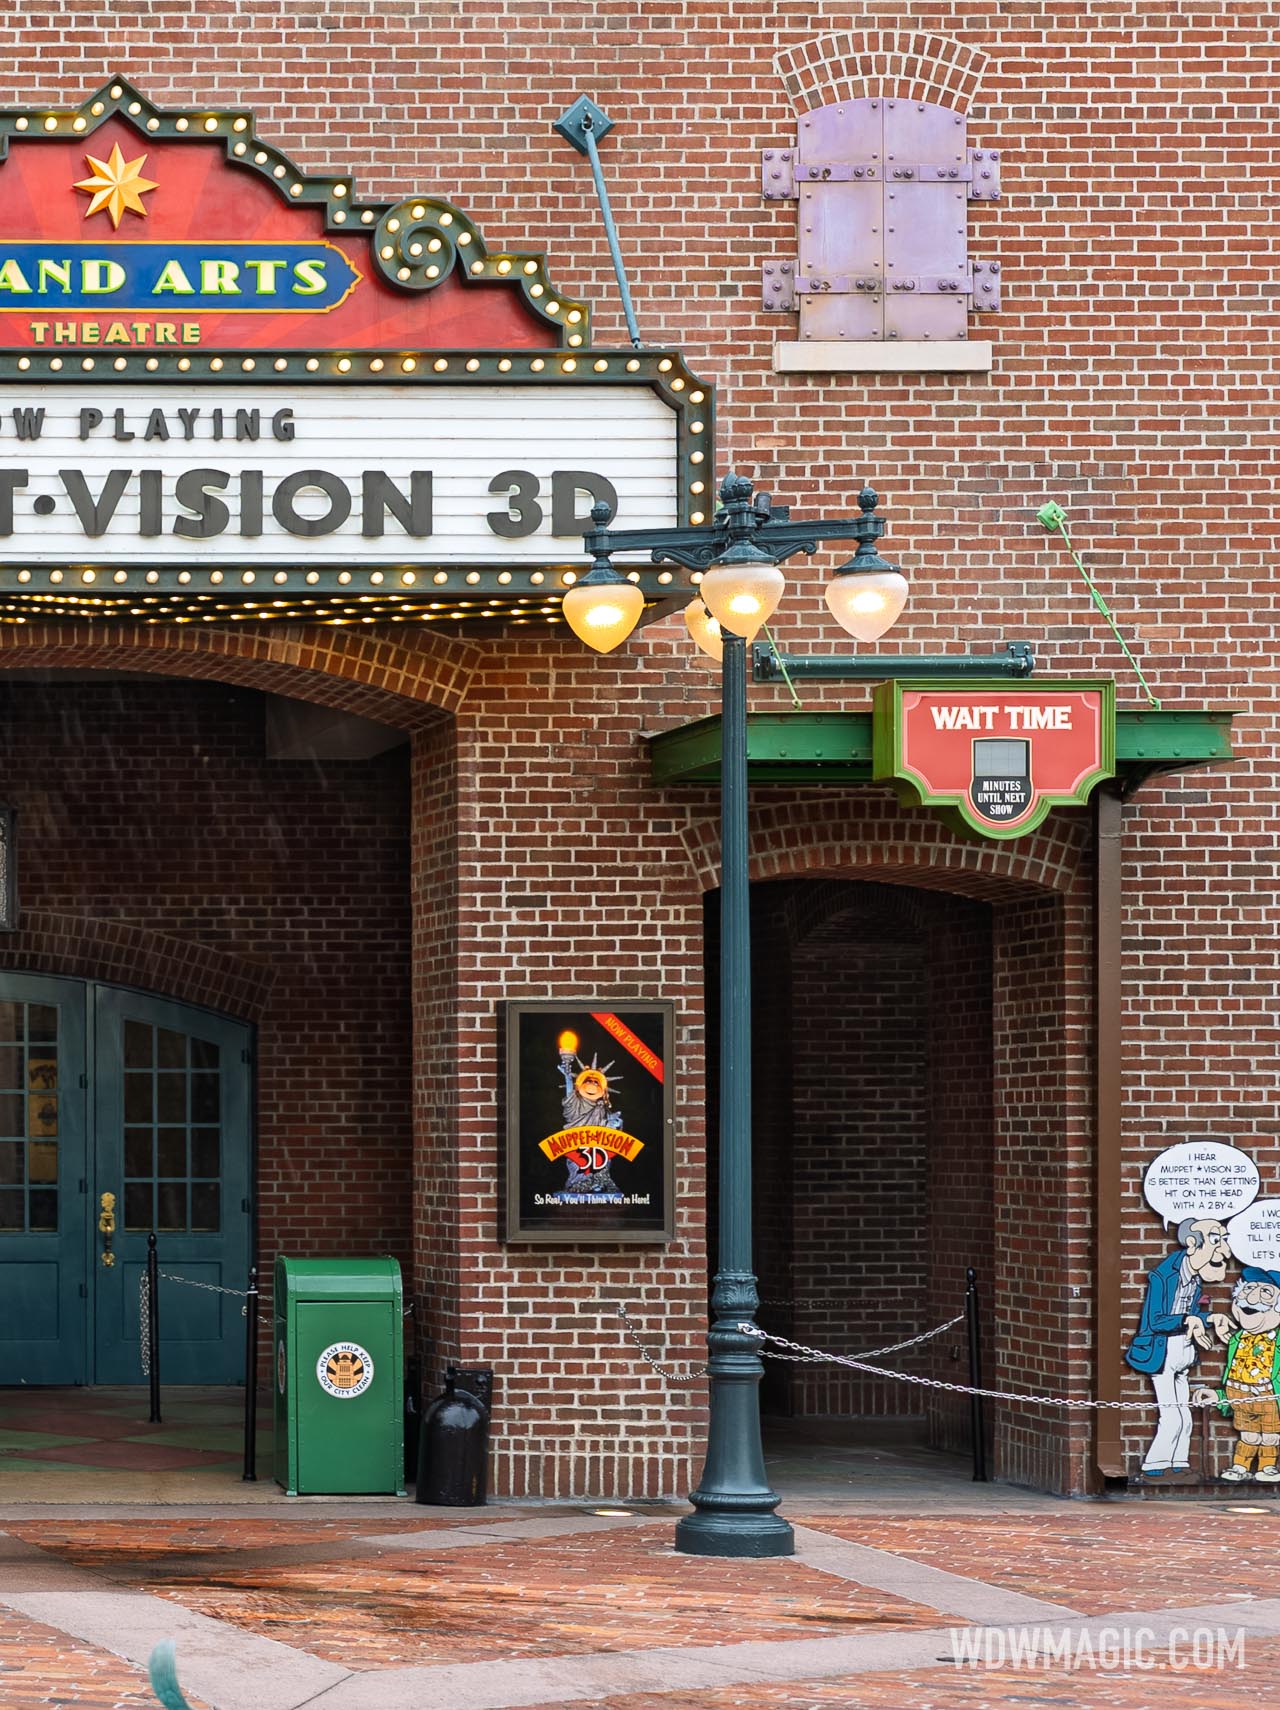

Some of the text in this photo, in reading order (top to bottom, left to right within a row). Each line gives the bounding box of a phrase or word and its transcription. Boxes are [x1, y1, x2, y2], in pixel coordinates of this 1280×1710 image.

[151, 259, 328, 295] ARTS
[30, 321, 201, 344] THEATRE
[79, 408, 295, 441] PLAYING
[487, 469, 618, 538] 3D
[930, 705, 1073, 730] WAIT TIME
[982, 780, 1021, 792] MINUTES
[977, 792, 1026, 803] UNTIL NEXT
[989, 804, 1014, 815] SHOW
[605, 1017, 658, 1070] NOW PLAYING
[578, 1146, 609, 1170] 3D
[1194, 1153, 1217, 1161] HEAR
[1160, 1165, 1247, 1174] MUPPET VISION 3D
[1148, 1177, 1257, 1186] IS BETTER THAN GETTING
[534, 1193, 544, 1205] So
[586, 1193, 608, 1205] Think
[1164, 1189, 1243, 1198] HIT ON THE HEAD
[1173, 1201, 1195, 1210] WITH
[1198, 1201, 1205, 1209] A
[1247, 1233, 1264, 1242] TILL
[320, 1346, 338, 1368] PLEASE
[359, 1352, 371, 1368] KEEP
[320, 1375, 333, 1390] OUR
[352, 1376, 370, 1394] CLEAN
